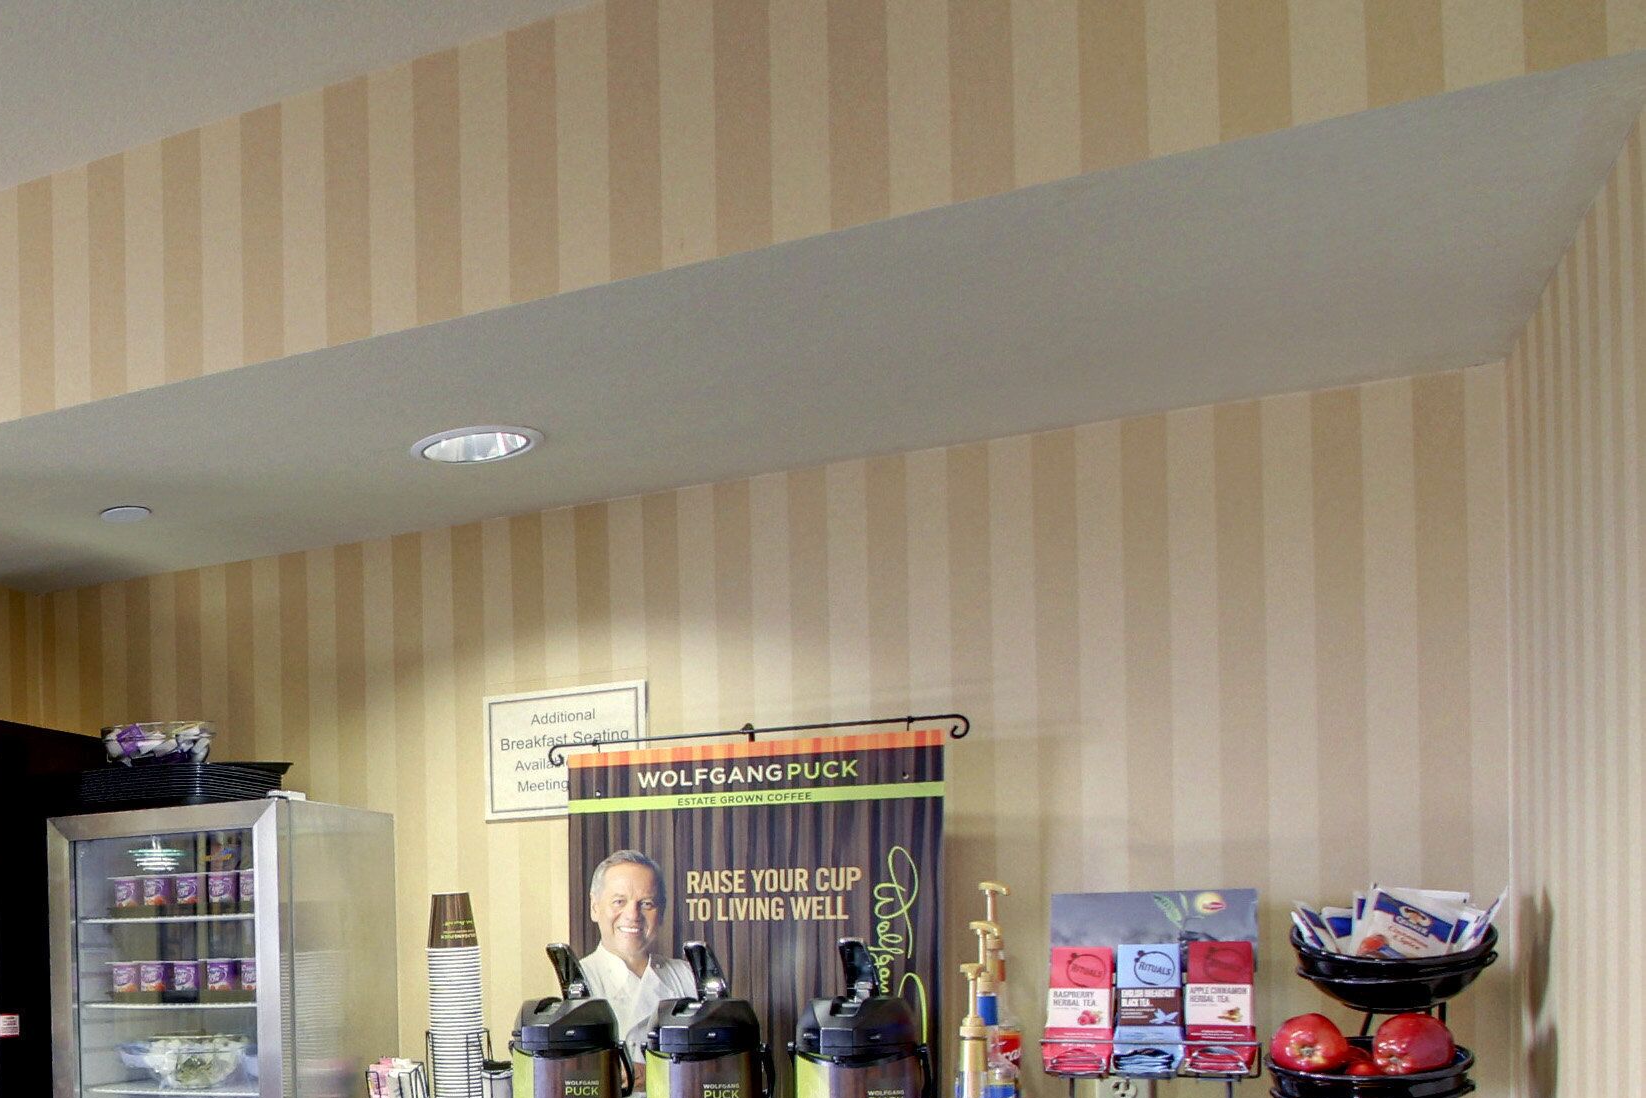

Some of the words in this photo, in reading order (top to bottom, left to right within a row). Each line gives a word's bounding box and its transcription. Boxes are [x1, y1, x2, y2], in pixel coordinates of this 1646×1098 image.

[530, 708, 596, 726] Additional
[500, 733, 568, 751] Breakfast
[573, 729, 629, 744] Seating
[515, 757, 566, 772] Availab
[517, 779, 569, 793] Meeting
[677, 797, 716, 806] ESTATE
[720, 794, 763, 804] GROWN
[767, 791, 812, 802] COFFEE
[686, 868, 746, 895] RAISE
[752, 867, 810, 893] YOUR
[815, 866, 862, 892] CUP
[686, 897, 711, 922] TO
[716, 896, 785, 922] LIVING
[789, 896, 850, 921] WELL
[1053, 990, 1095, 999] RASPBERRY
[565, 1086, 599, 1096] PUCK
